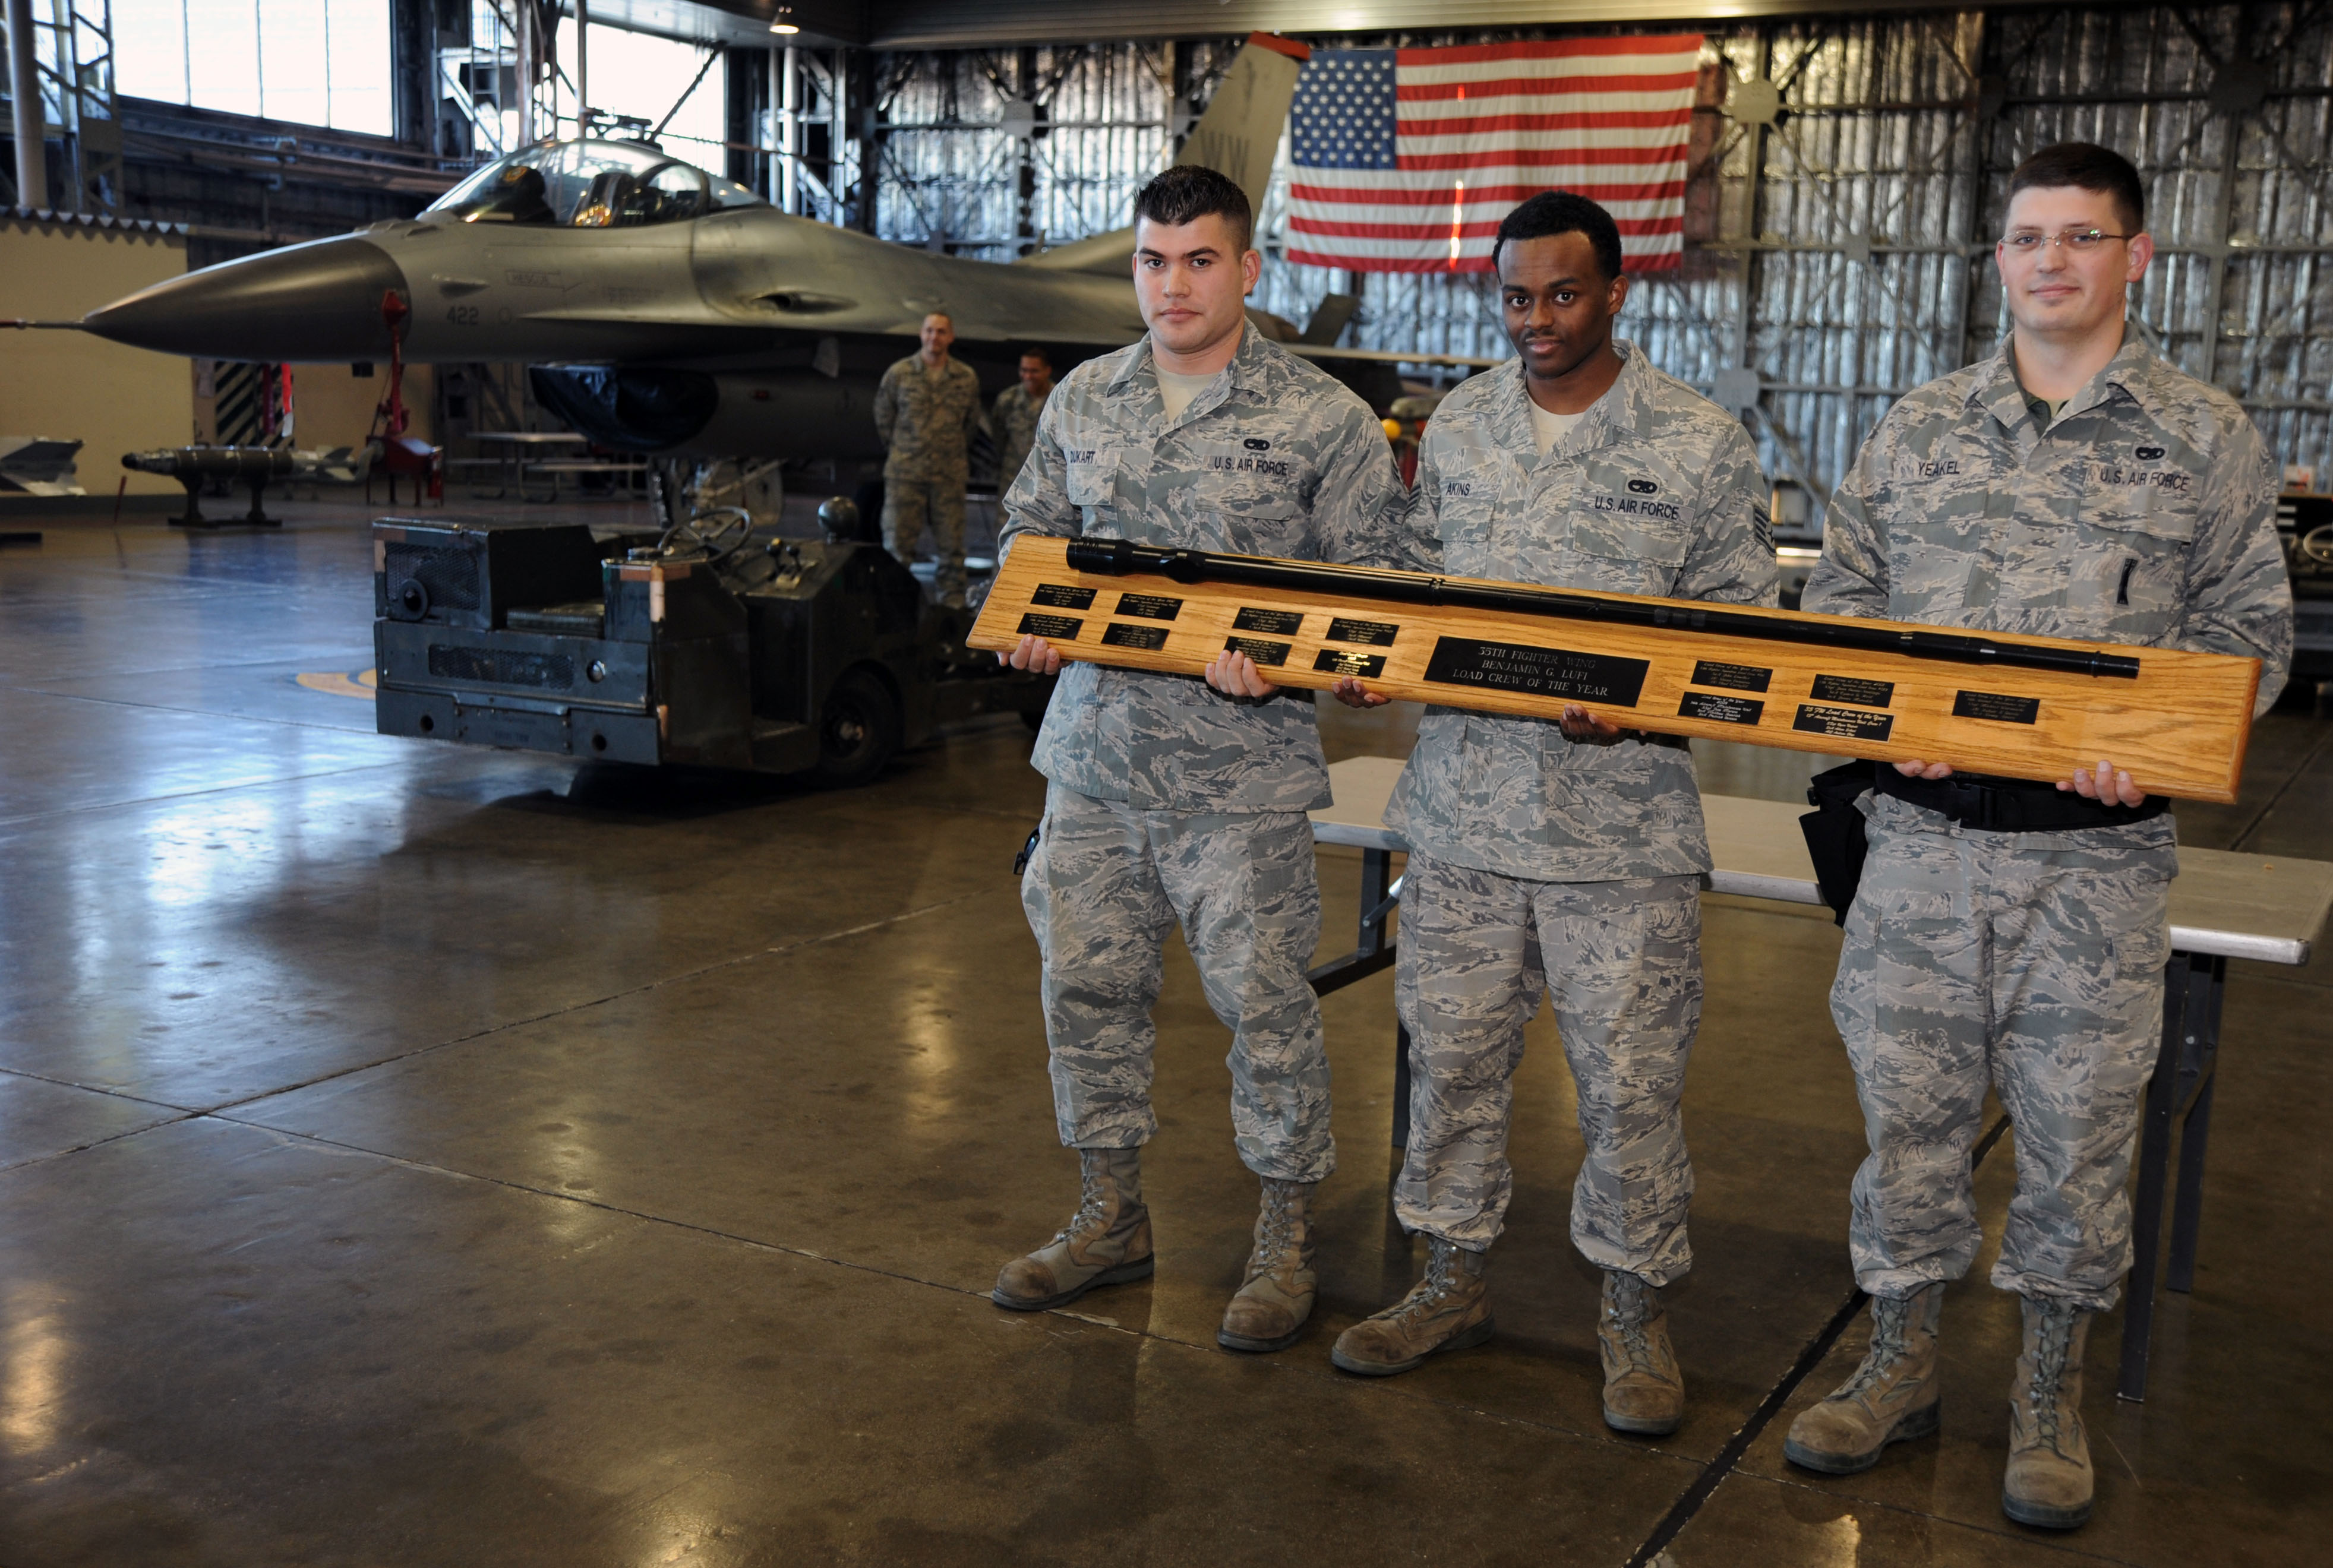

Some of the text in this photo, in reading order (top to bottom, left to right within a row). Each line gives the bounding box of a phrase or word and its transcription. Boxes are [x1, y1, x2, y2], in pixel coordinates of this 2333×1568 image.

[446, 305, 479, 325] 422
[1070, 450, 1096, 464] DUKART
[1237, 457, 1254, 472] AIR
[1256, 459, 1289, 476] FORCE
[1918, 460, 1960, 477] YEAKEL
[1445, 482, 1470, 497] AKINS
[2128, 472, 2147, 486] AIR
[2149, 472, 2190, 492] FORCE
[1618, 498, 1638, 514] AIR
[1640, 502, 1680, 520] FORCE
[1478, 646, 1596, 669] 35TH FIGHTER WING
[1482, 659, 1540, 675] BENJAMIN
[1546, 666, 1555, 677] G.
[1453, 668, 1609, 697] LOAD CREW OF THE YEAR
